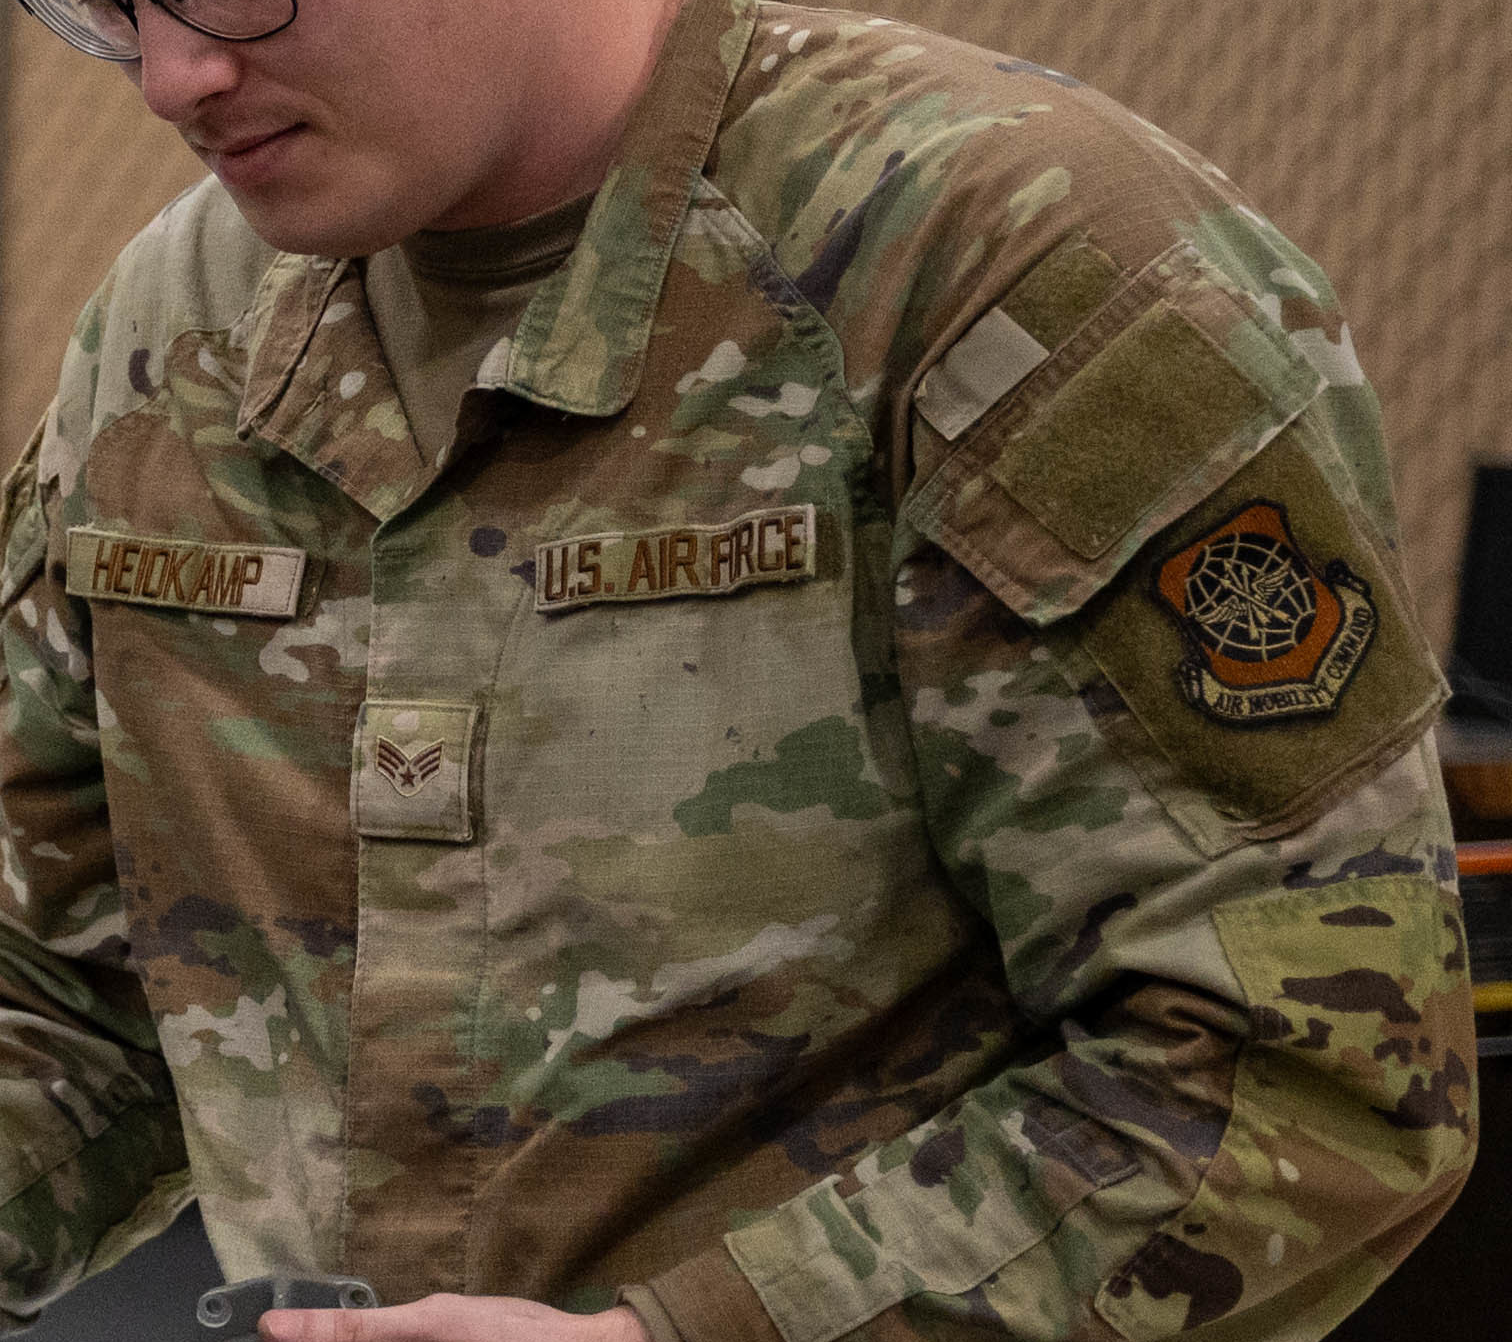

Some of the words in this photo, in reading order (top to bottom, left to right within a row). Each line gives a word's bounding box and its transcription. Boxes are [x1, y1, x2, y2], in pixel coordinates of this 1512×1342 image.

[92, 539, 264, 607] HEIDKAMP
[544, 540, 614, 601] U.S.
[627, 532, 700, 592] AIR
[1216, 693, 1243, 712] AIR
[1250, 680, 1334, 711] MOBILITY
[1325, 608, 1371, 679] COMMAND
